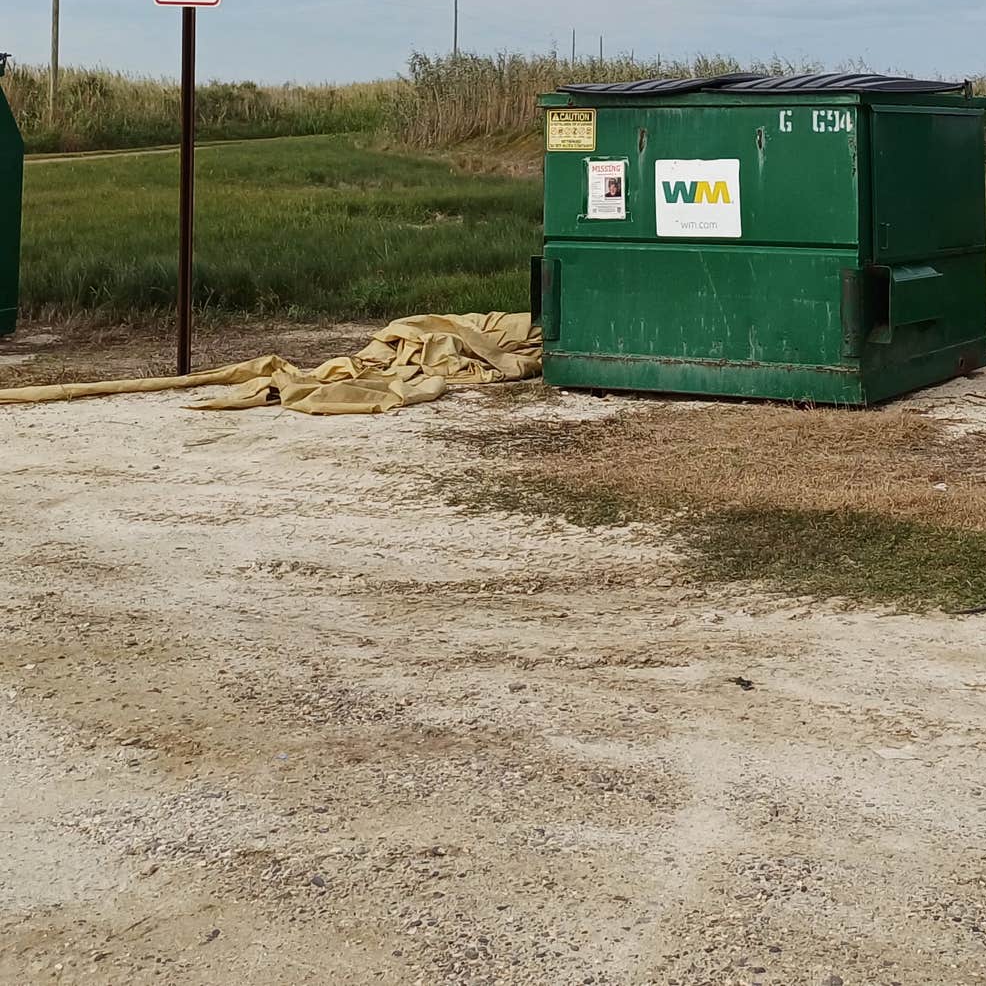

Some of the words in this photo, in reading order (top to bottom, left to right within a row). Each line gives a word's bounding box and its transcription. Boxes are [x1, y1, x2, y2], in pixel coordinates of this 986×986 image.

[559, 112, 590, 121] CAUTION
[591, 164, 621, 173] MISSING
[661, 180, 731, 204] WM
[680, 221, 718, 230] wm.com
